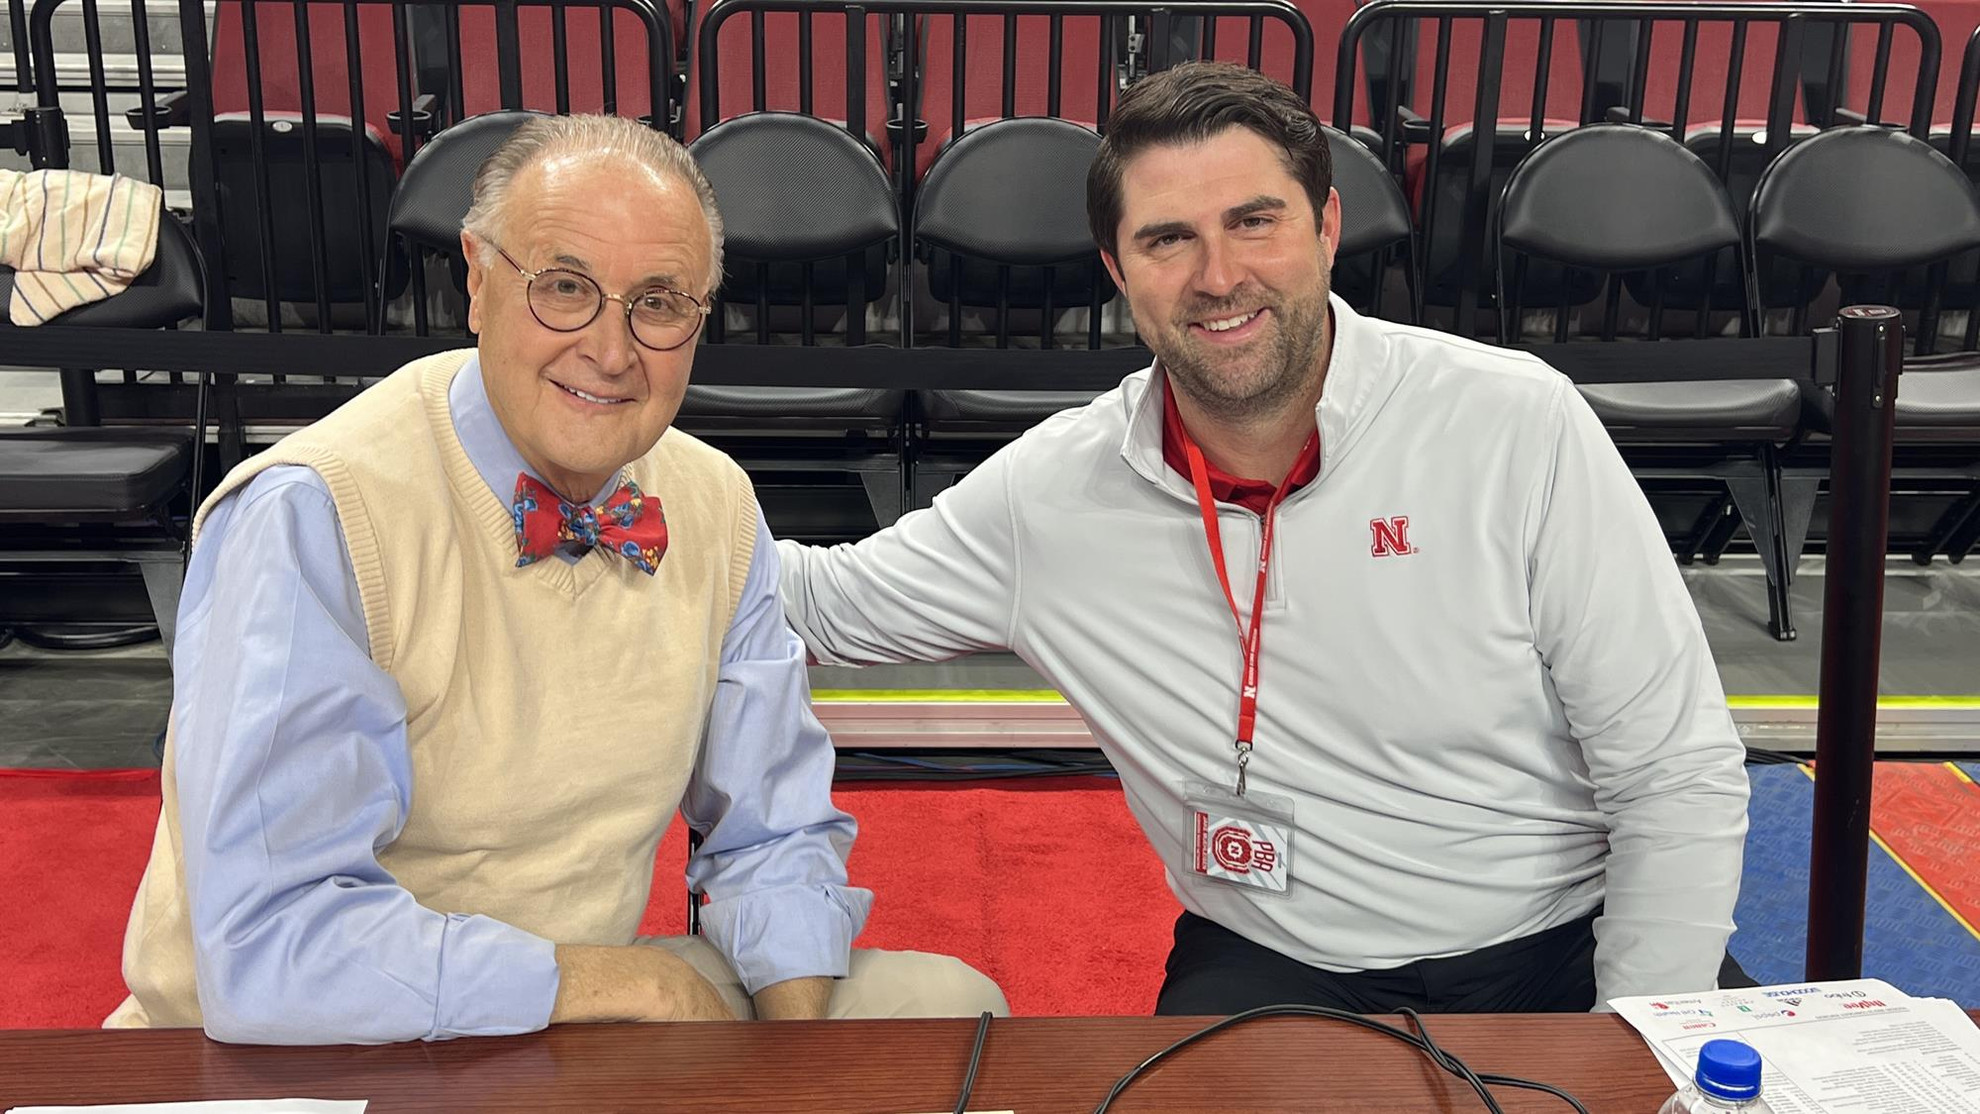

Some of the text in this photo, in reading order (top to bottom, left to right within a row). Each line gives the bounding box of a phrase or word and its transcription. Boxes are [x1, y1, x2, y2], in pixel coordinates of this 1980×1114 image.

[1370, 516, 1411, 557] N
[1243, 686, 1256, 698] N
[1230, 845, 1239, 855] N
[1252, 841, 1275, 872] PBA
